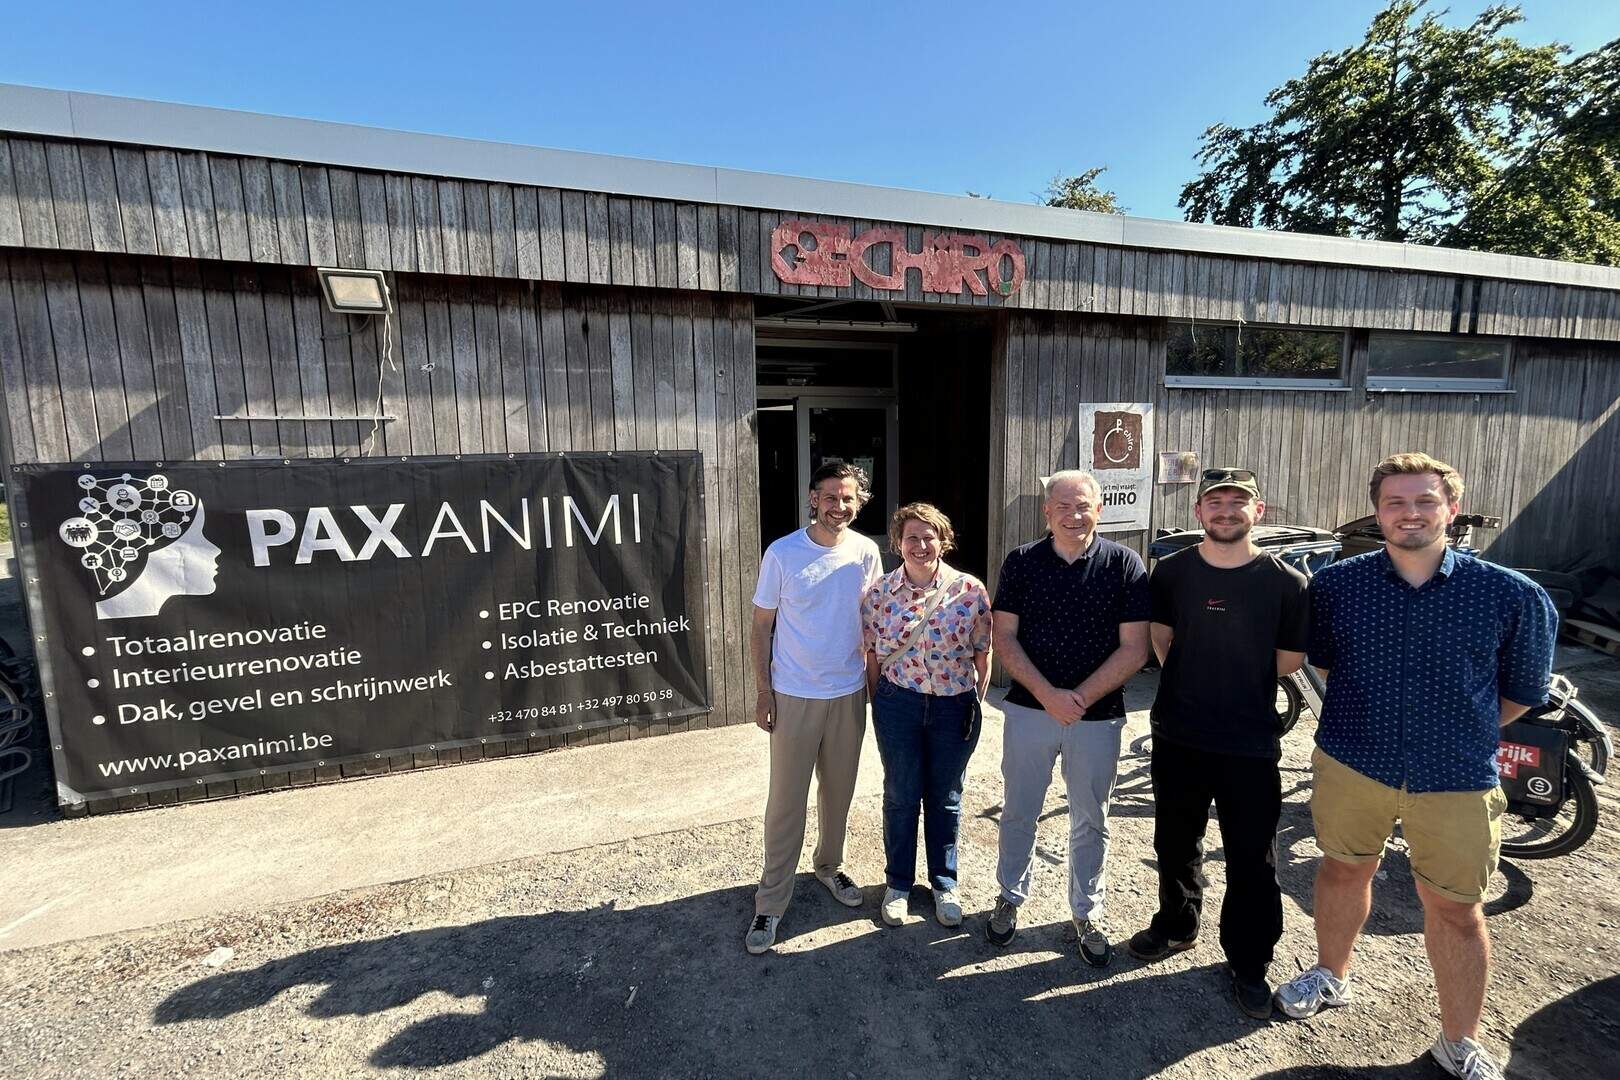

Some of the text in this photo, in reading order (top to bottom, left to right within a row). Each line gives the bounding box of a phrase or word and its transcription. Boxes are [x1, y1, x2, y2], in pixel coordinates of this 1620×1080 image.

[1100, 492, 1137, 506] HIRO
[245, 493, 641, 567] PAX ANIMI
[499, 592, 650, 621] EPC Renovatie
[106, 621, 327, 658] Totaalrenovatie
[501, 615, 691, 650] Isolatie & Techniek
[112, 647, 362, 689] Interieurrenovatie
[504, 650, 658, 680] Asbestattesten
[118, 669, 453, 725] Dak, gevel en schrijnwerk
[488, 689, 673, 723] +32 470 84 81 +32 497 80 50 58
[98, 731, 333, 777] www.paxanimi.be
